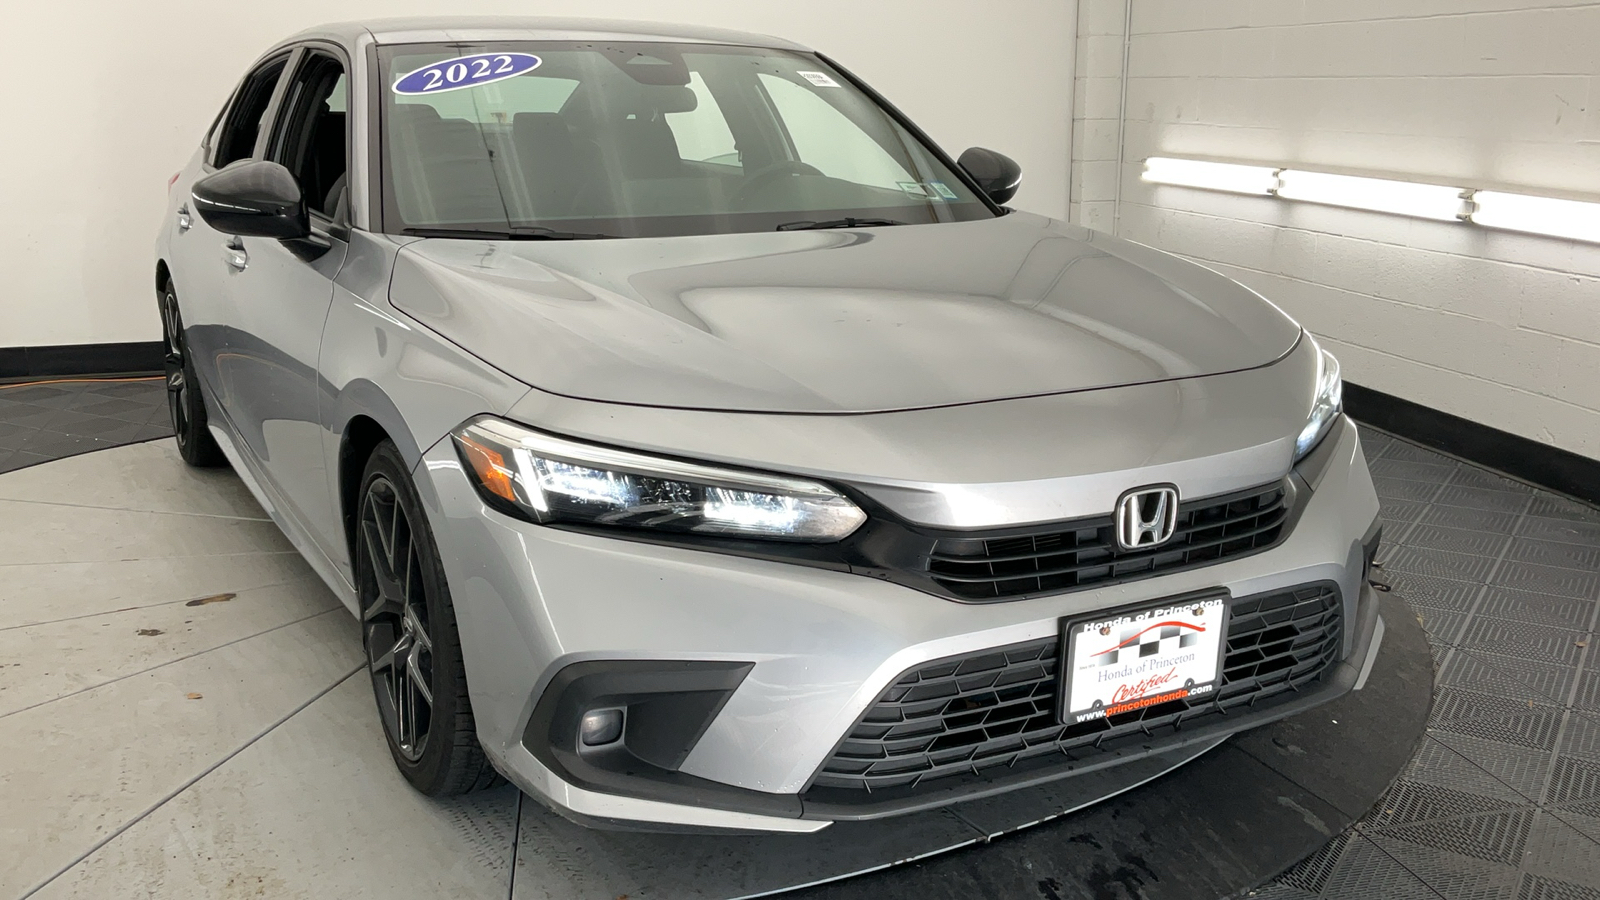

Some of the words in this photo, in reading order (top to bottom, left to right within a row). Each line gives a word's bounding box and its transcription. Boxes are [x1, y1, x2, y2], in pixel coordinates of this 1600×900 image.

[423, 55, 514, 91] 2022
[1083, 616, 1131, 633] Honda
[1136, 611, 1151, 623] of
[1153, 599, 1223, 618] Princeton
[1098, 666, 1132, 682] Honda
[1136, 659, 1150, 673] of
[1150, 653, 1195, 670] Princeton
[1112, 667, 1178, 704] Certified
[1076, 684, 1213, 723] www.princetonhonda.com
